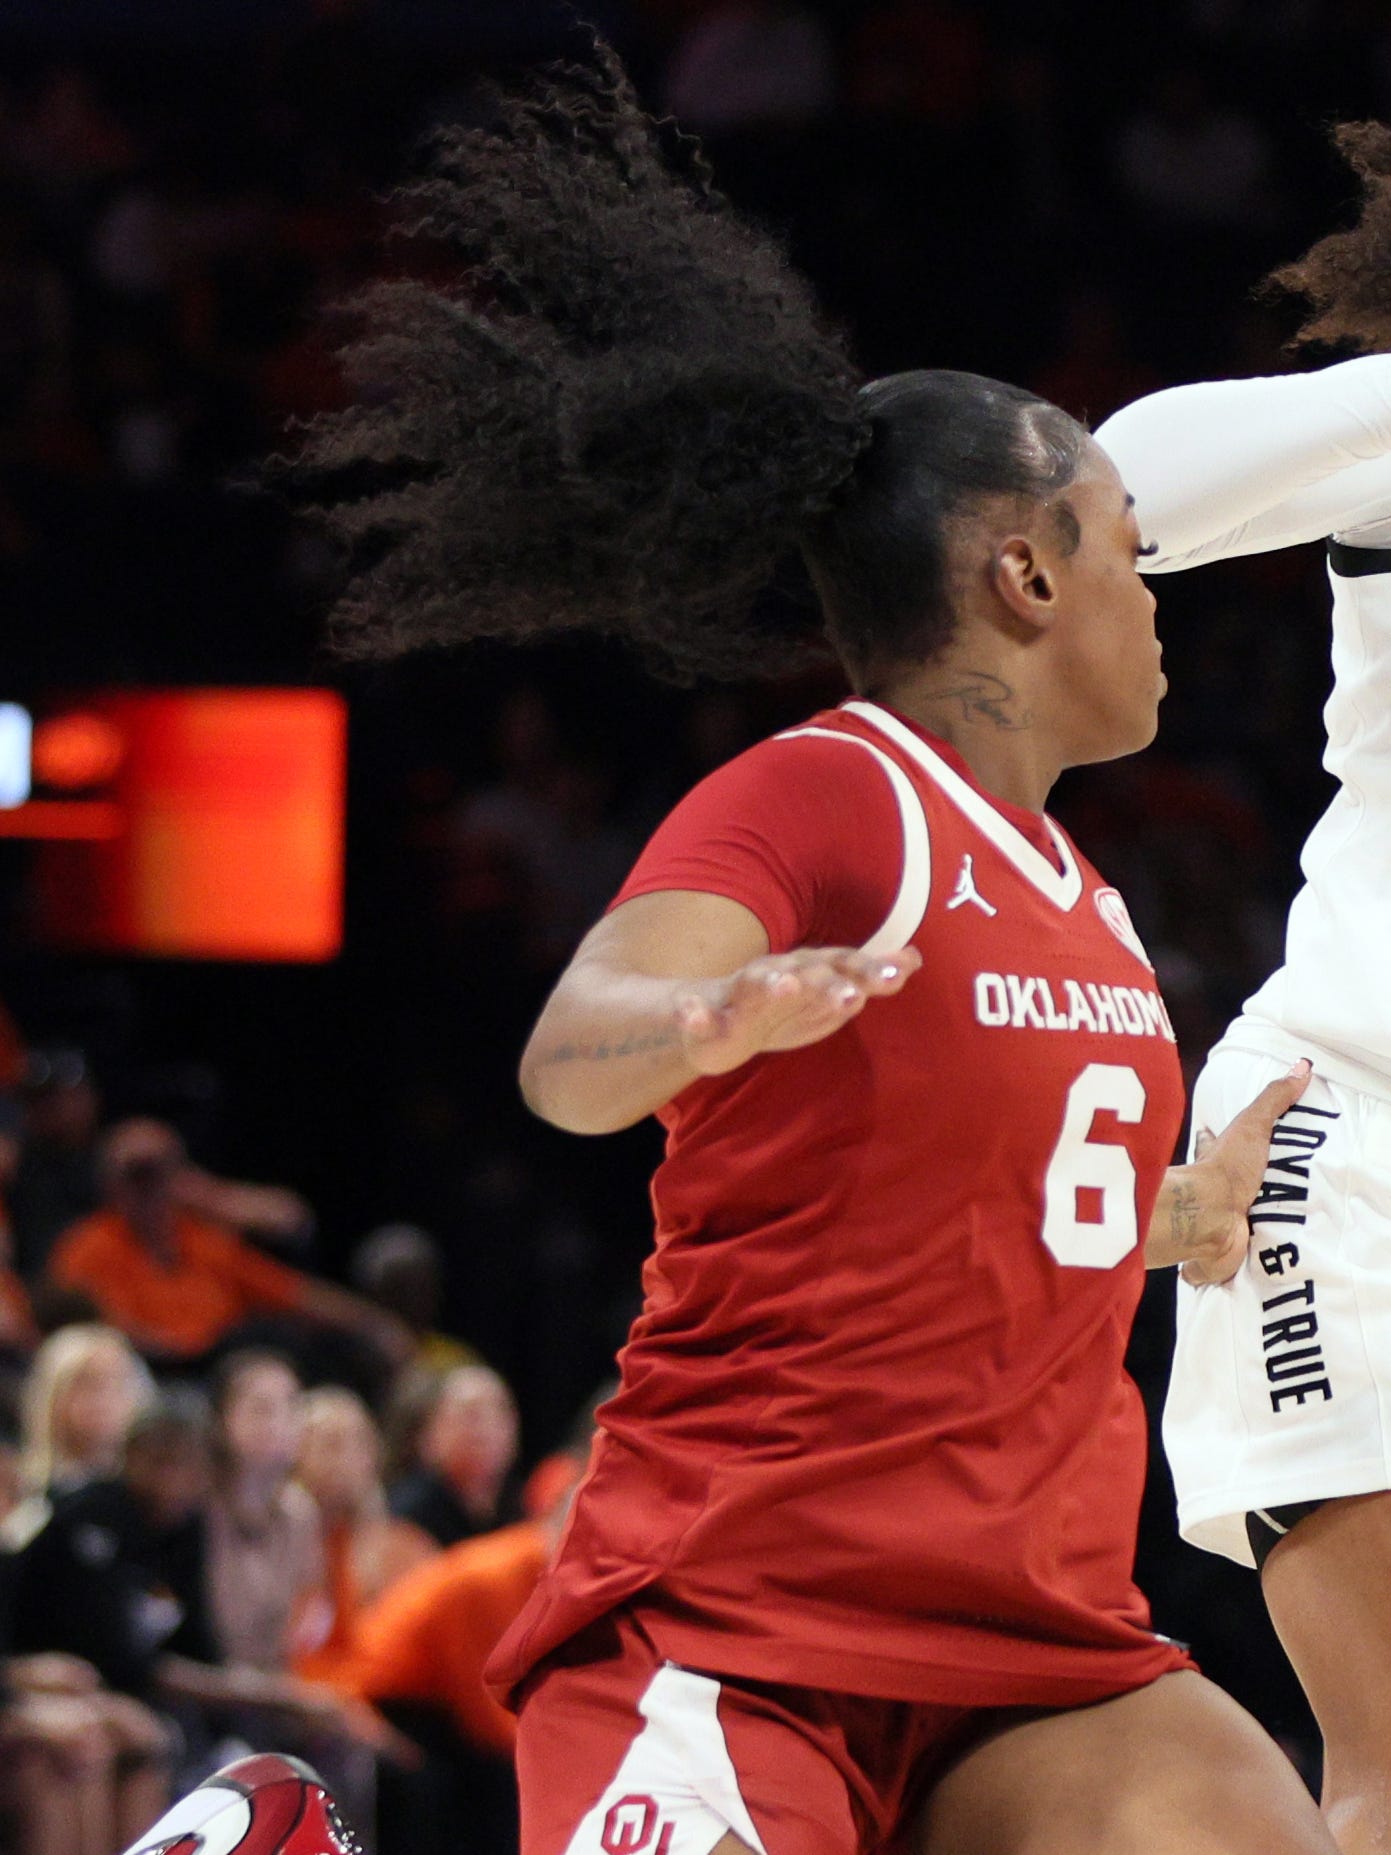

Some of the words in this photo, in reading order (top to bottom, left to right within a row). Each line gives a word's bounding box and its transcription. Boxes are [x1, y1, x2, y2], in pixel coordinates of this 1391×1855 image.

[974, 972, 1177, 1043] OKLAHOM
[1042, 1063, 1147, 1269] 6
[1248, 1104, 1341, 1236] LOYAL
[1258, 1242, 1299, 1276] &
[1261, 1279, 1333, 1413] TRUE
